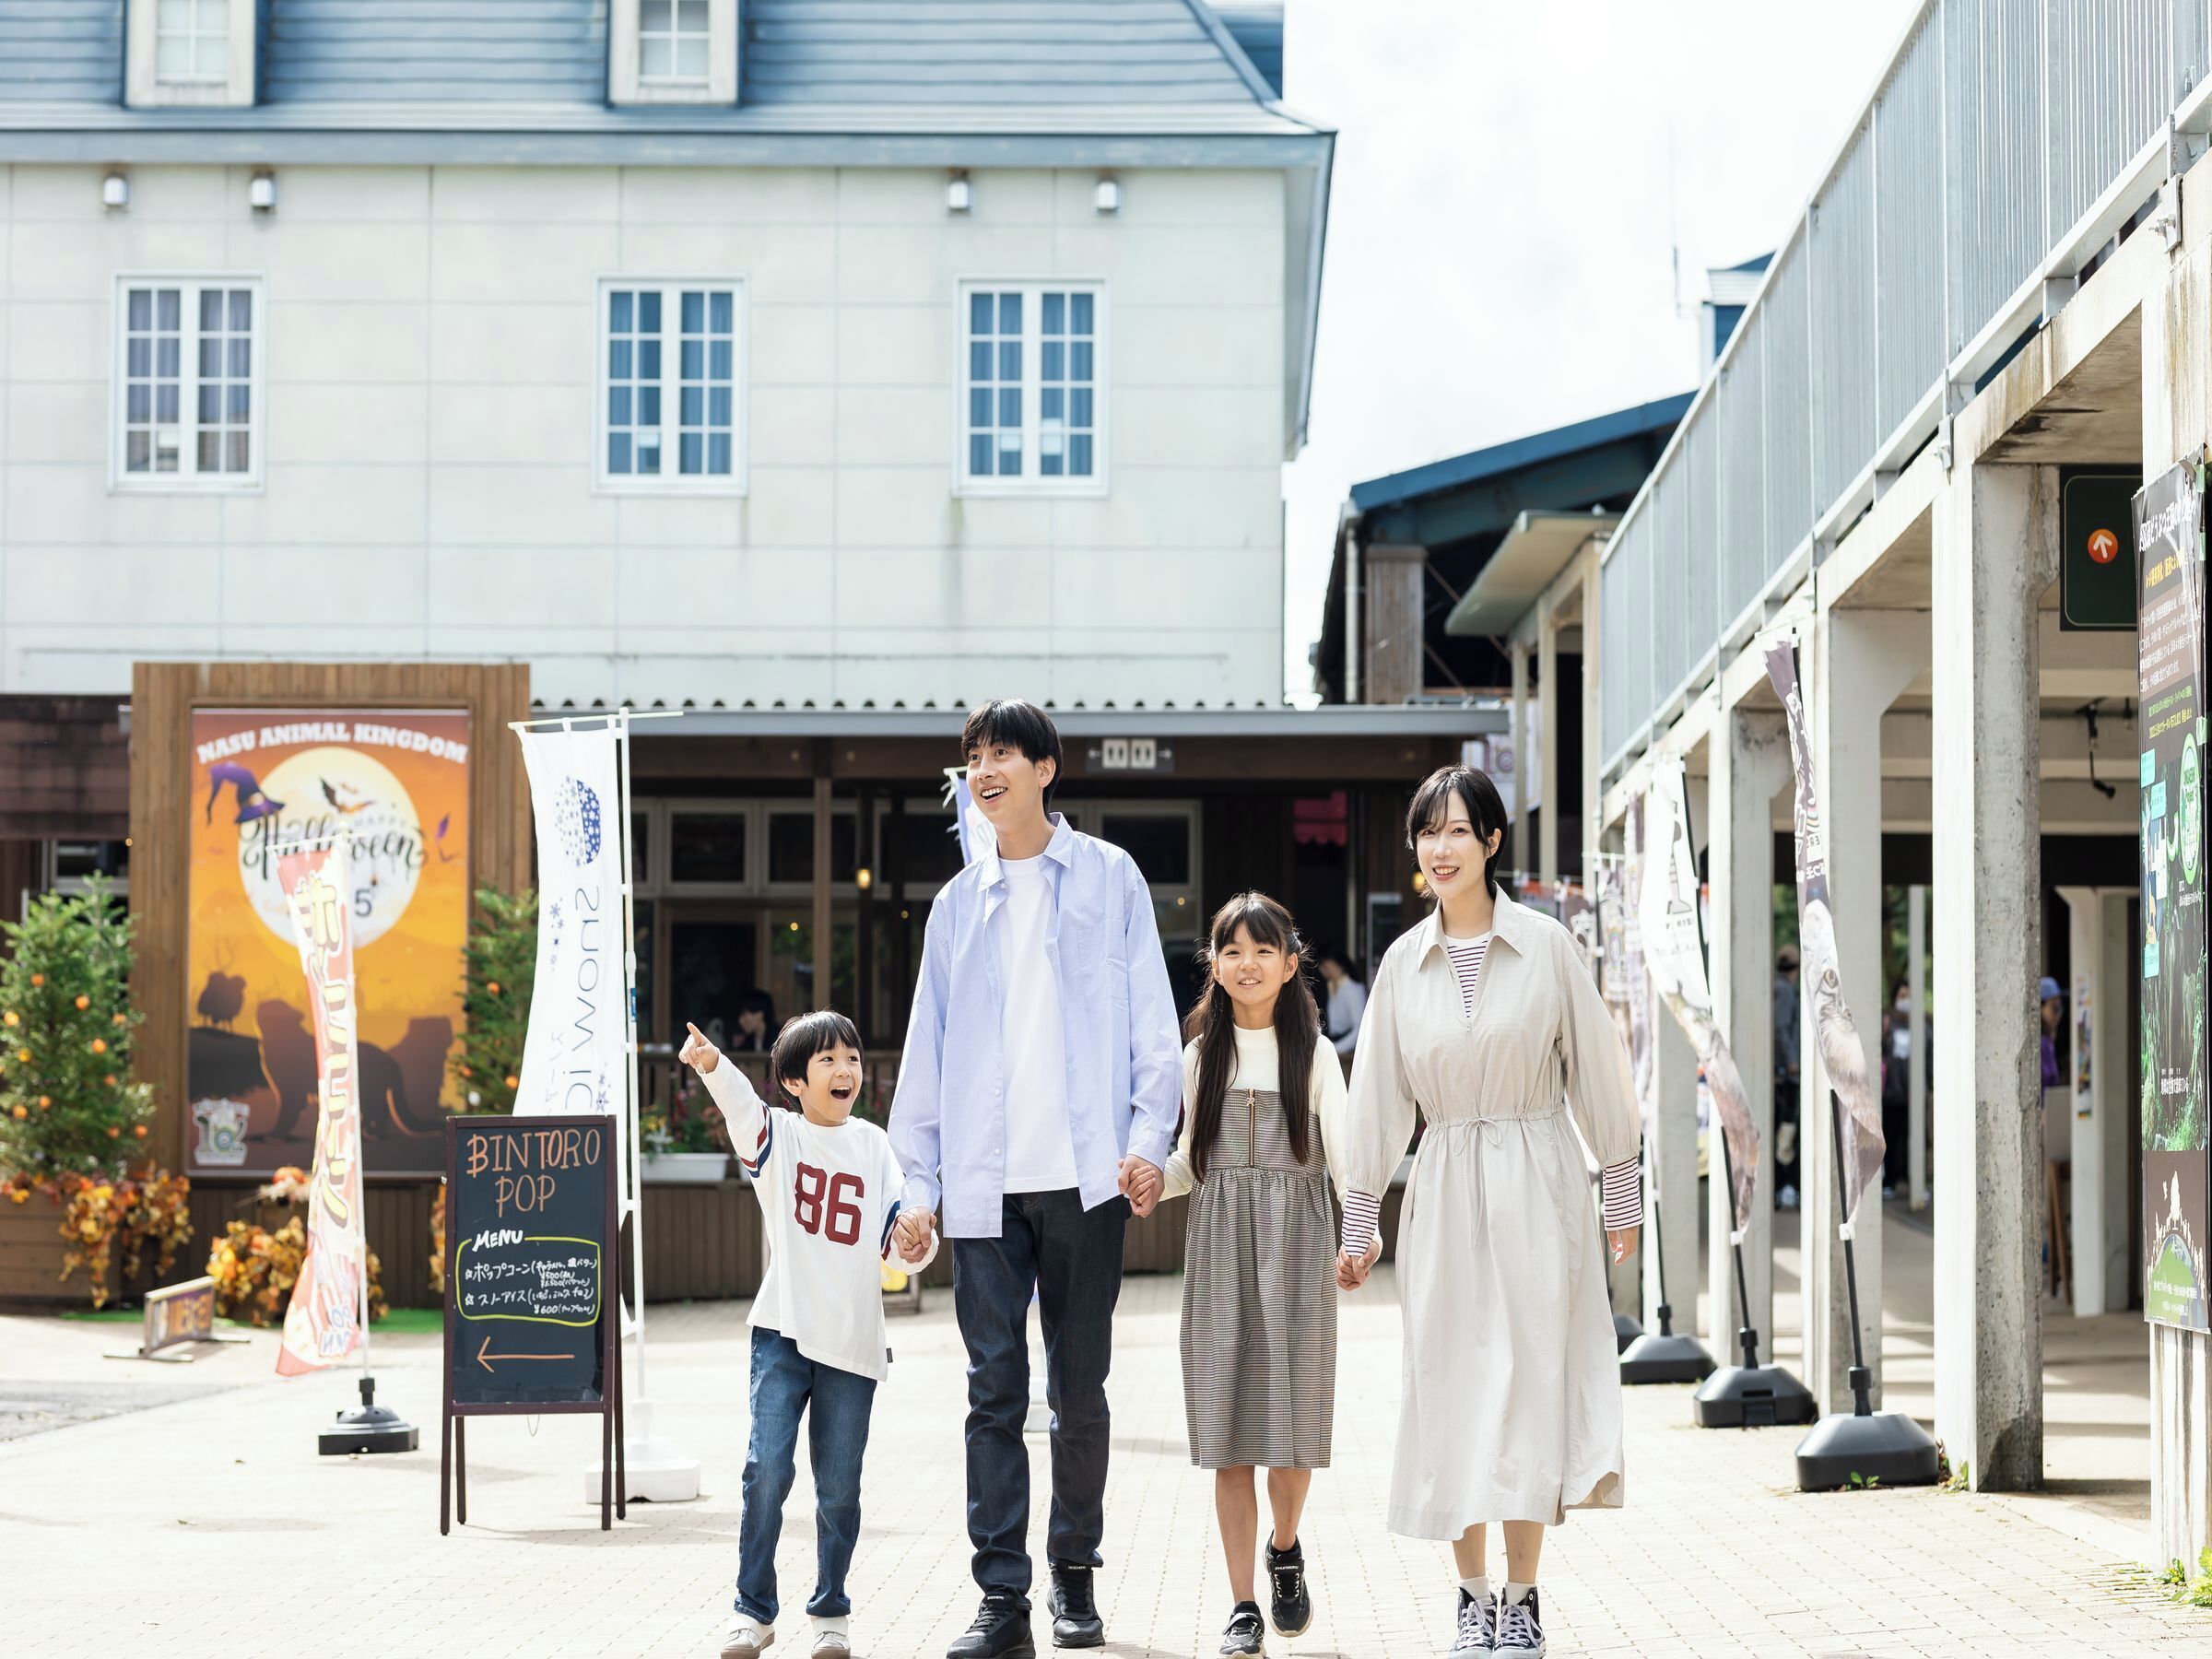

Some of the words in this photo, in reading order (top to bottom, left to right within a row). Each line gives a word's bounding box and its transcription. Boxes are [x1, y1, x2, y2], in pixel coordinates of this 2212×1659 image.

[196, 731, 256, 765] NASU
[259, 723, 350, 748] ANIMAL
[353, 724, 468, 764] KINGDOM
[466, 1128, 601, 1178] BINTORO
[495, 1174, 556, 1218] POP
[794, 1161, 865, 1246] 86
[472, 1229, 523, 1253] MENU
